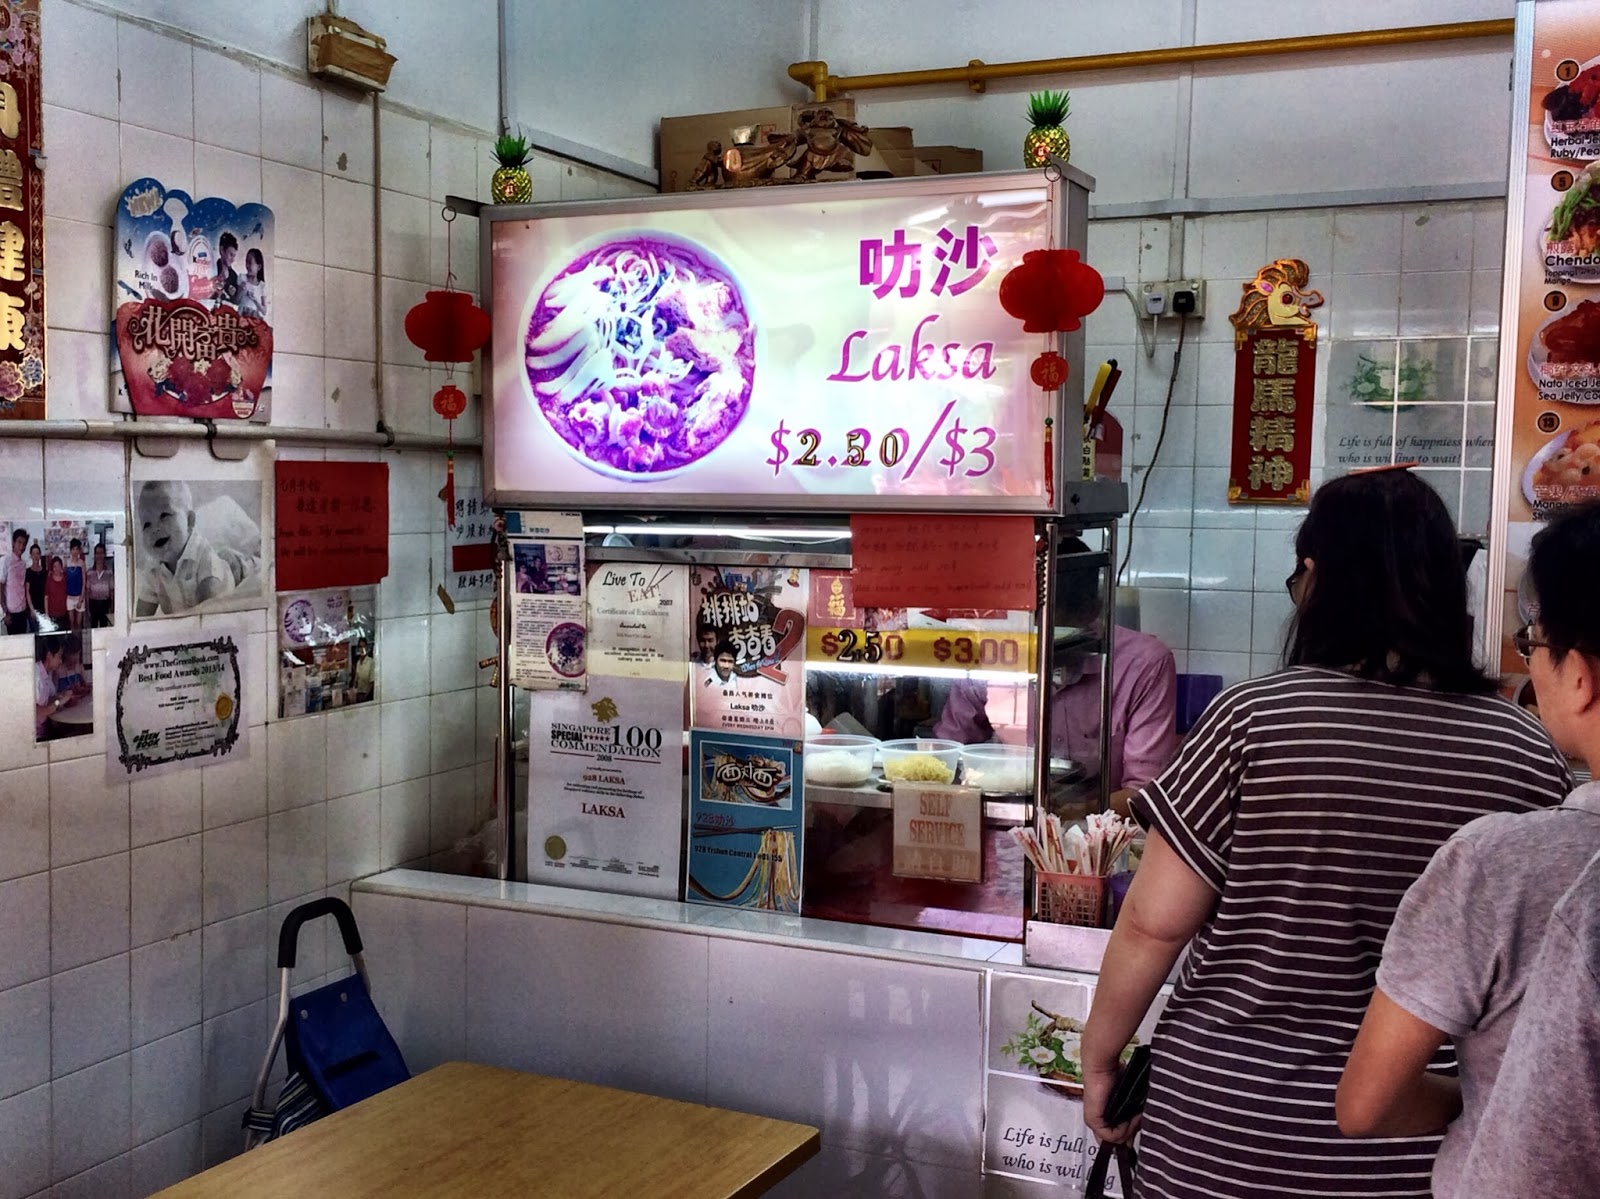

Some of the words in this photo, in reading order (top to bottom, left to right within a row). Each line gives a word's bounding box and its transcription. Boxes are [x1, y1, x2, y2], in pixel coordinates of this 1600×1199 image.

[1551, 136, 1585, 147] Herbal
[859, 225, 999, 300] 叻沙
[135, 270, 150, 280] Rich
[138, 305, 248, 360] 花開富貴
[826, 314, 998, 382] Laksa
[1539, 379, 1563, 388] Nata
[1538, 391, 1557, 401] Sea
[1560, 391, 1581, 402] Jelly
[1584, 391, 1600, 401] Co
[1248, 338, 1300, 491] 龍馬精神
[1339, 435, 1361, 448] Life
[1363, 437, 1372, 447] is
[1373, 435, 1392, 450] full
[1396, 435, 1409, 450] of
[1339, 453, 1361, 464] who
[1363, 454, 1372, 463] is
[1418, 454, 1429, 464] to
[602, 571, 627, 586] Live
[630, 572, 646, 587] To
[596, 607, 628, 616] Certificate
[702, 592, 759, 628] 排排站
[729, 624, 776, 664] 查查看
[757, 607, 805, 687] 2
[933, 637, 1019, 665] $3.00
[138, 673, 153, 683] Best
[155, 670, 172, 681] Food
[174, 667, 200, 678] Awards
[730, 703, 750, 711] Laksa
[133, 732, 160, 743] GREEN
[136, 739, 160, 749] BOOK
[551, 730, 583, 742] SPECIAL
[551, 723, 611, 735] SINGAPORE
[611, 725, 662, 750] 100
[551, 740, 661, 758] COMMENDATION
[599, 775, 625, 785] LAKSA
[717, 762, 777, 787] 面对面
[582, 802, 625, 818] LAKSA
[919, 791, 953, 817] SELF
[909, 819, 965, 847] SERVICE
[729, 849, 752, 858] Central
[1003, 1127, 1035, 1148] Life
[1040, 1132, 1052, 1148] is
[1051, 1135, 1083, 1154] full
[1002, 1153, 1035, 1170] who
[1040, 1158, 1053, 1174] is
